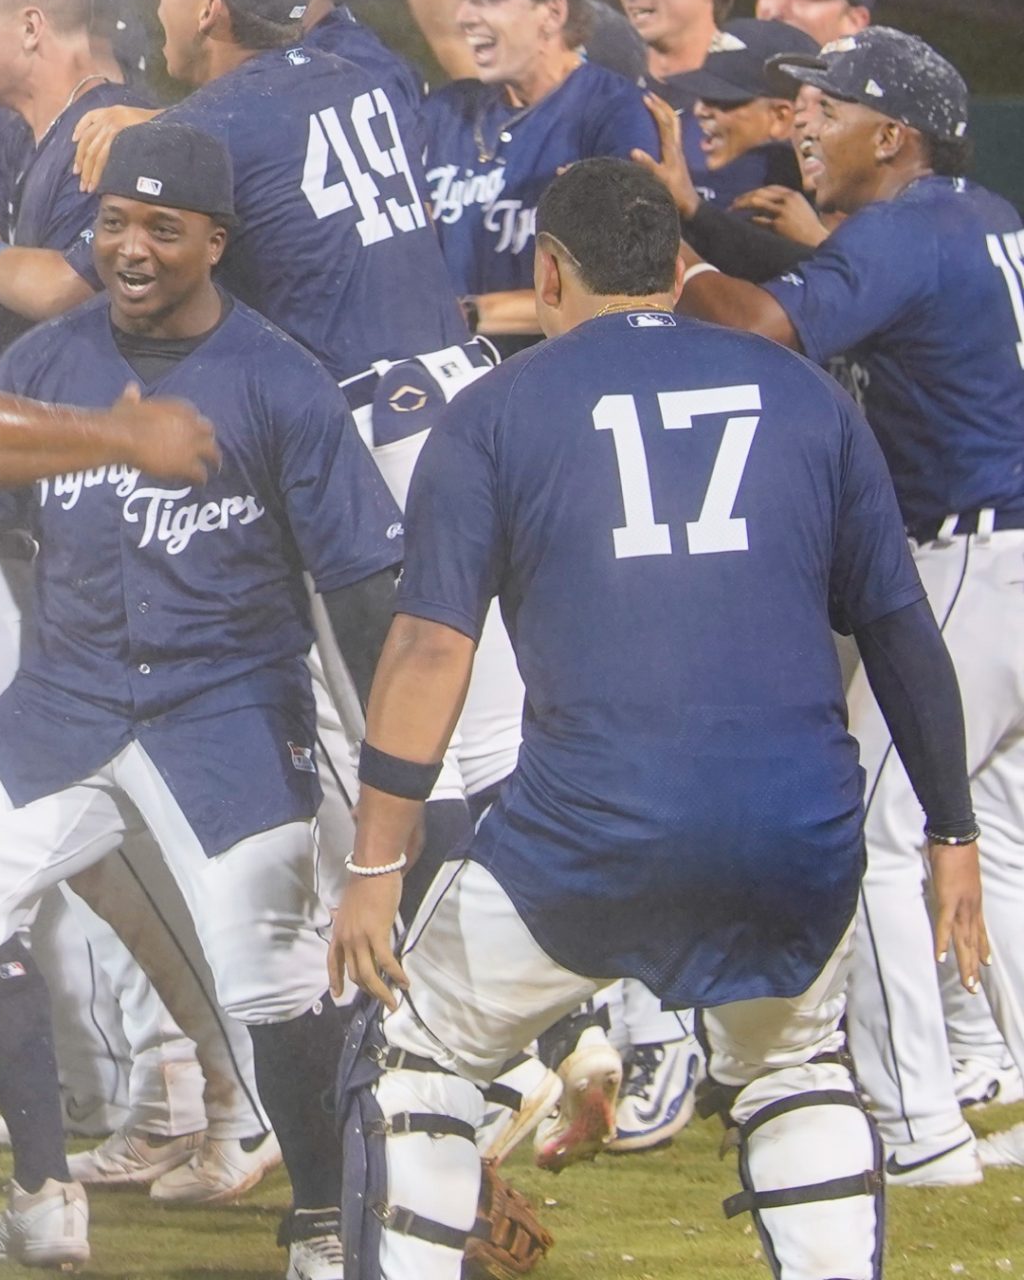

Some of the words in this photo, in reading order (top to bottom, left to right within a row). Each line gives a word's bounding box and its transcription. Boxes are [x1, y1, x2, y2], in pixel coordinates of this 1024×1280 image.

[300, 87, 427, 248] 49
[425, 164, 506, 224] Flying
[985, 229, 1024, 370] 1
[122, 485, 265, 555] Tigers
[592, 383, 762, 559] 17
